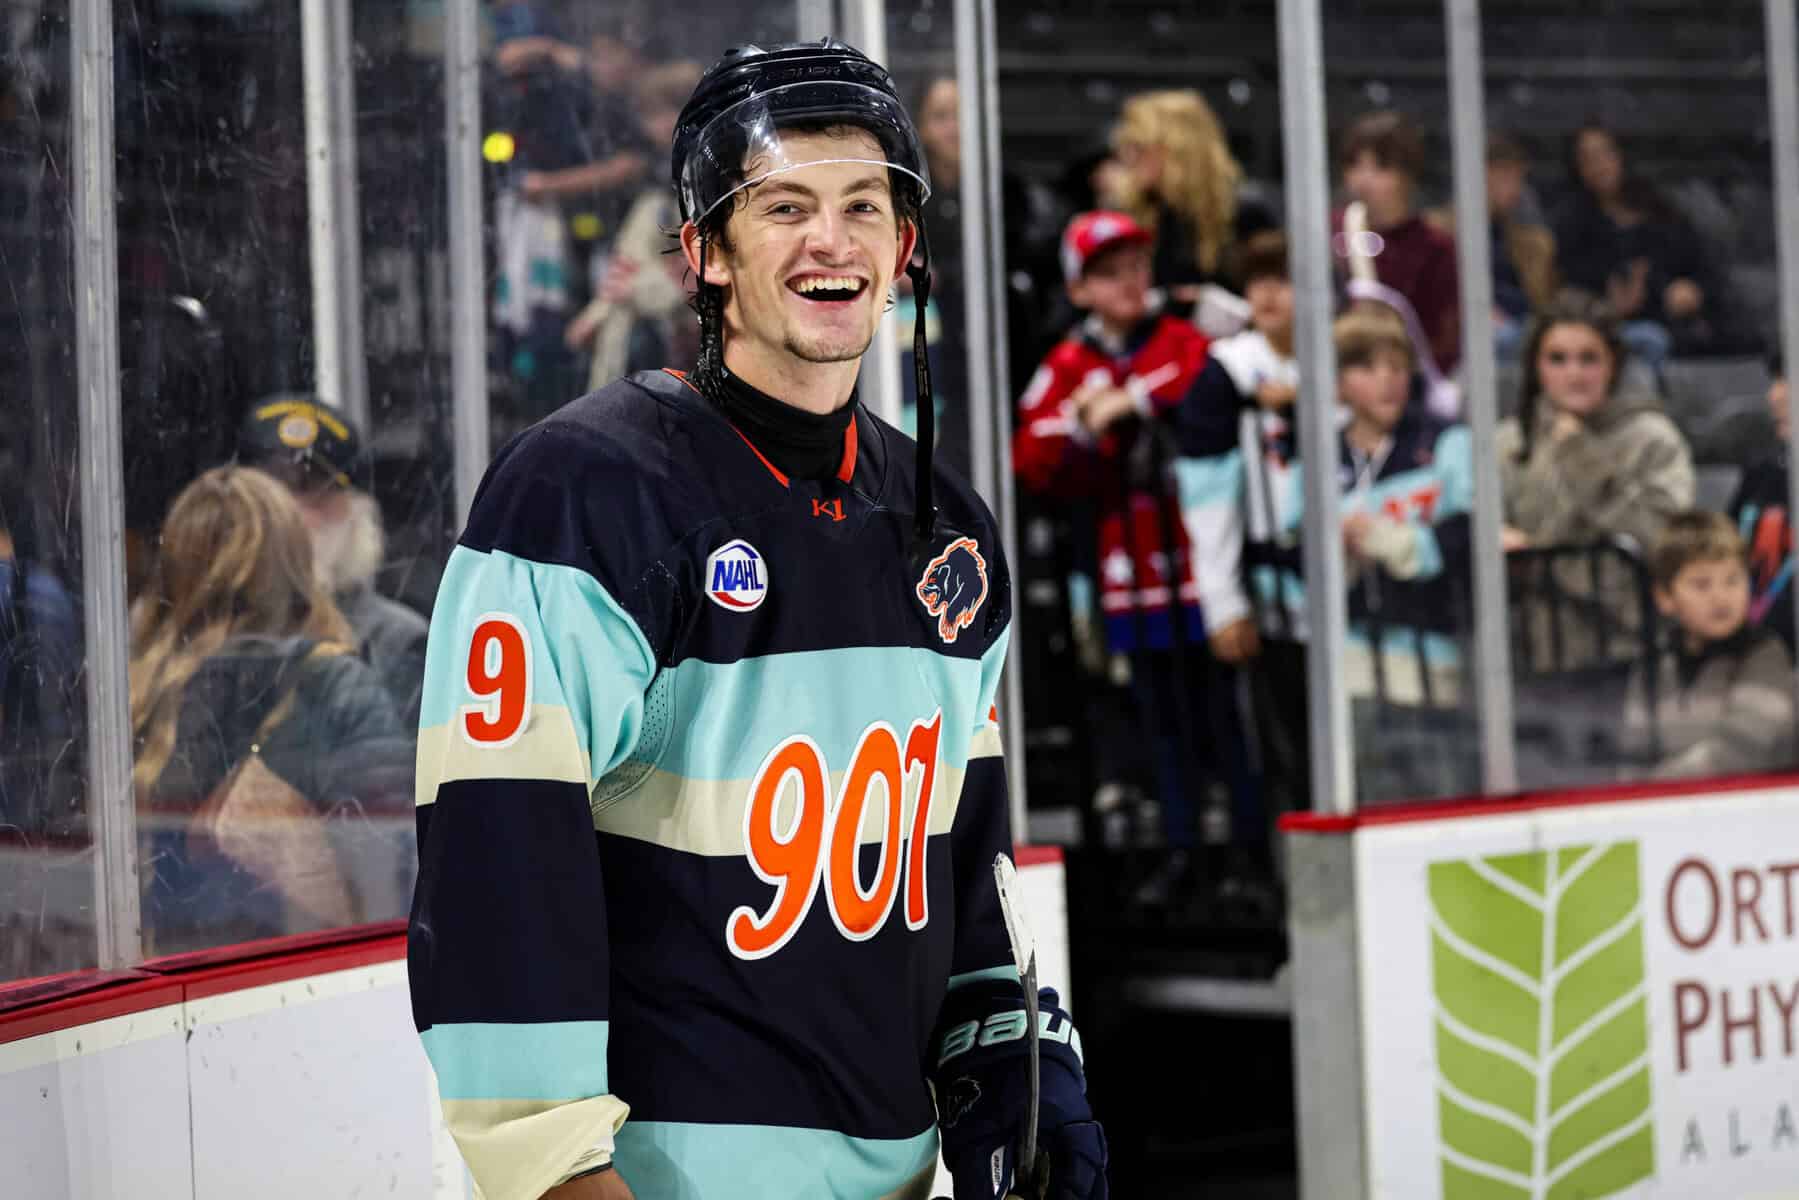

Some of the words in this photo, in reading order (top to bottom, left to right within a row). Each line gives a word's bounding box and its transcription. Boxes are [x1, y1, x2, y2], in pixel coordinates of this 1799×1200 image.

[712, 560, 764, 591] NAHL
[462, 613, 533, 747] 9
[726, 706, 942, 959] 907
